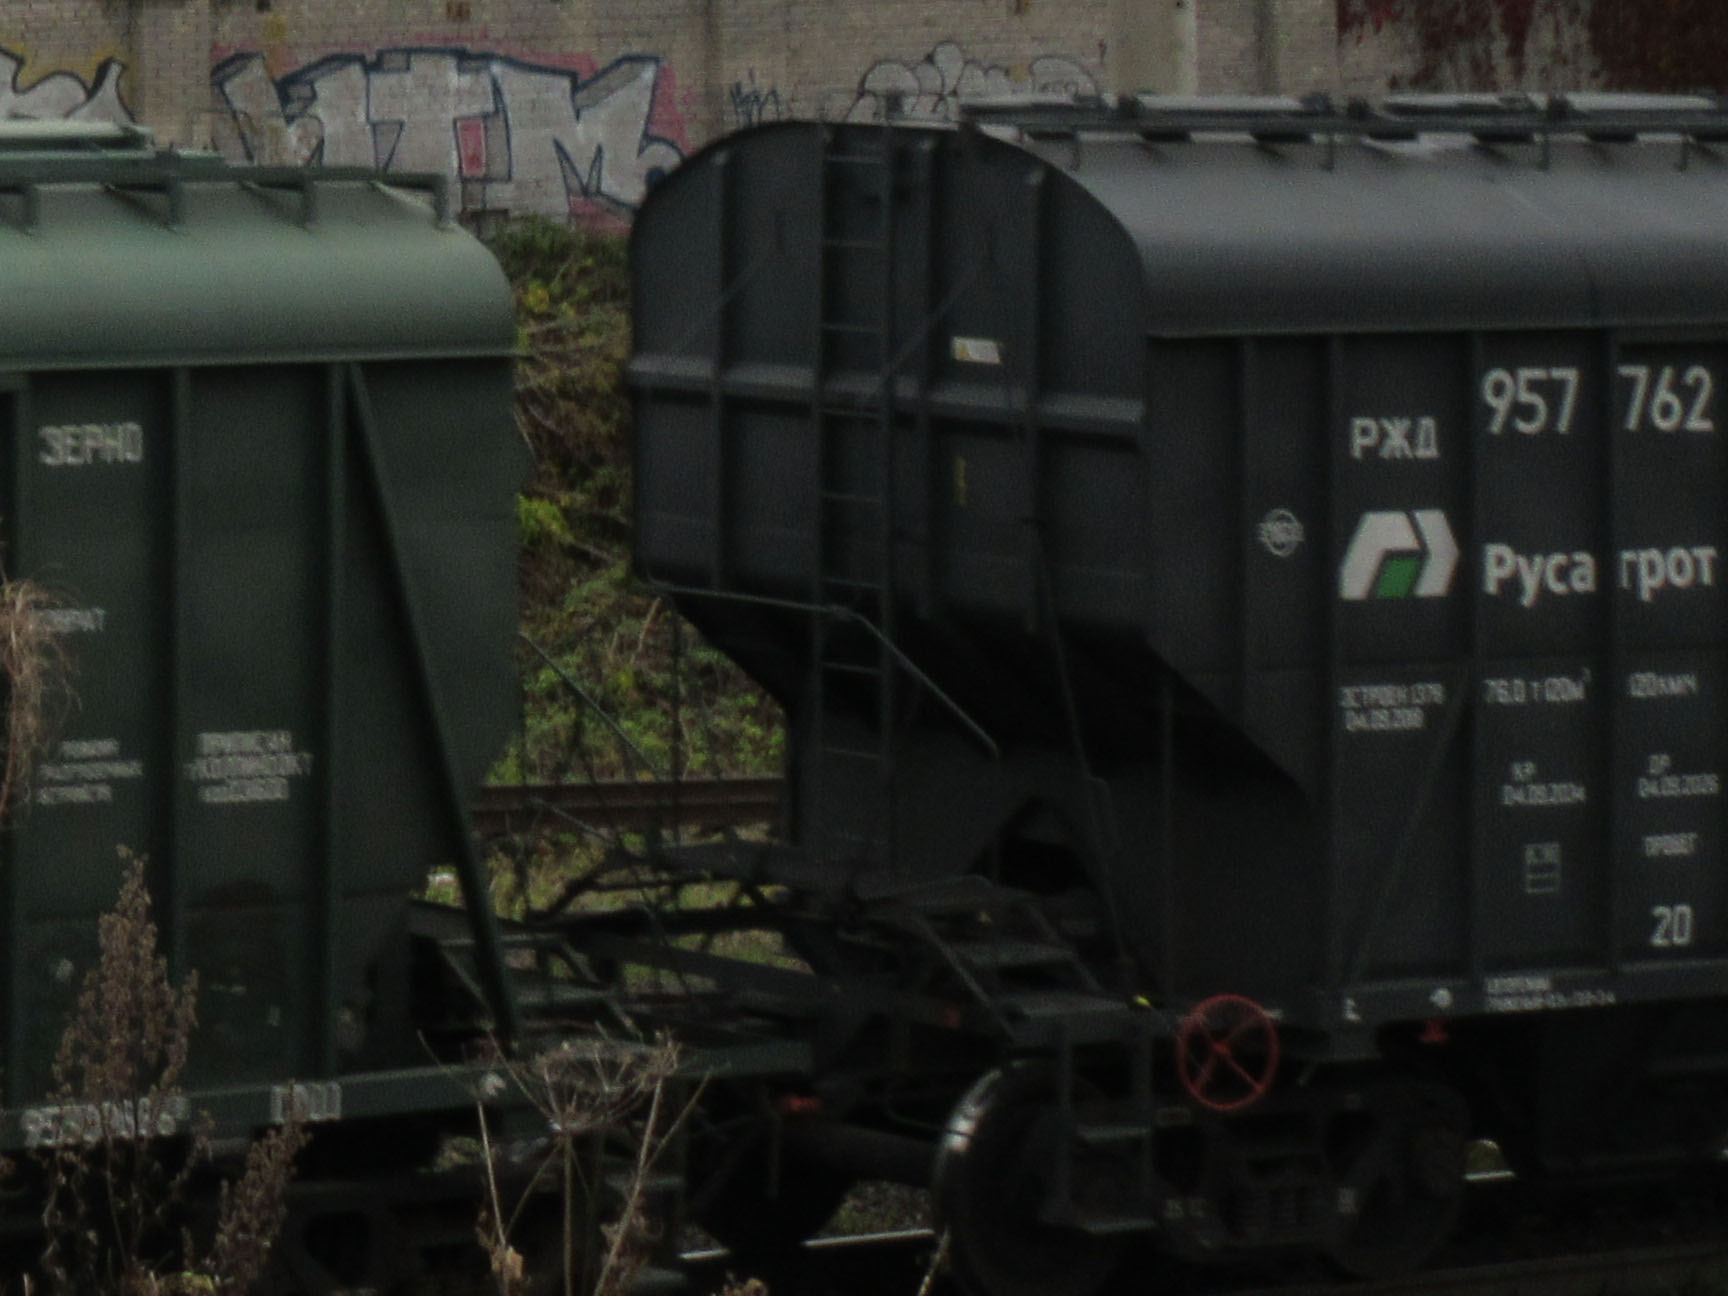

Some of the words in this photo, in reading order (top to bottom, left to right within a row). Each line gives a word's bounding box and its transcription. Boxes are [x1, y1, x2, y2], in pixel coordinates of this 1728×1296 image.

[1481, 366, 1579, 436] 957
[1617, 364, 1715, 433] 762
[38, 421, 144, 467] ЗЕРНО
[1350, 416, 1440, 460] РЖД
[1651, 905, 1693, 948] 20
